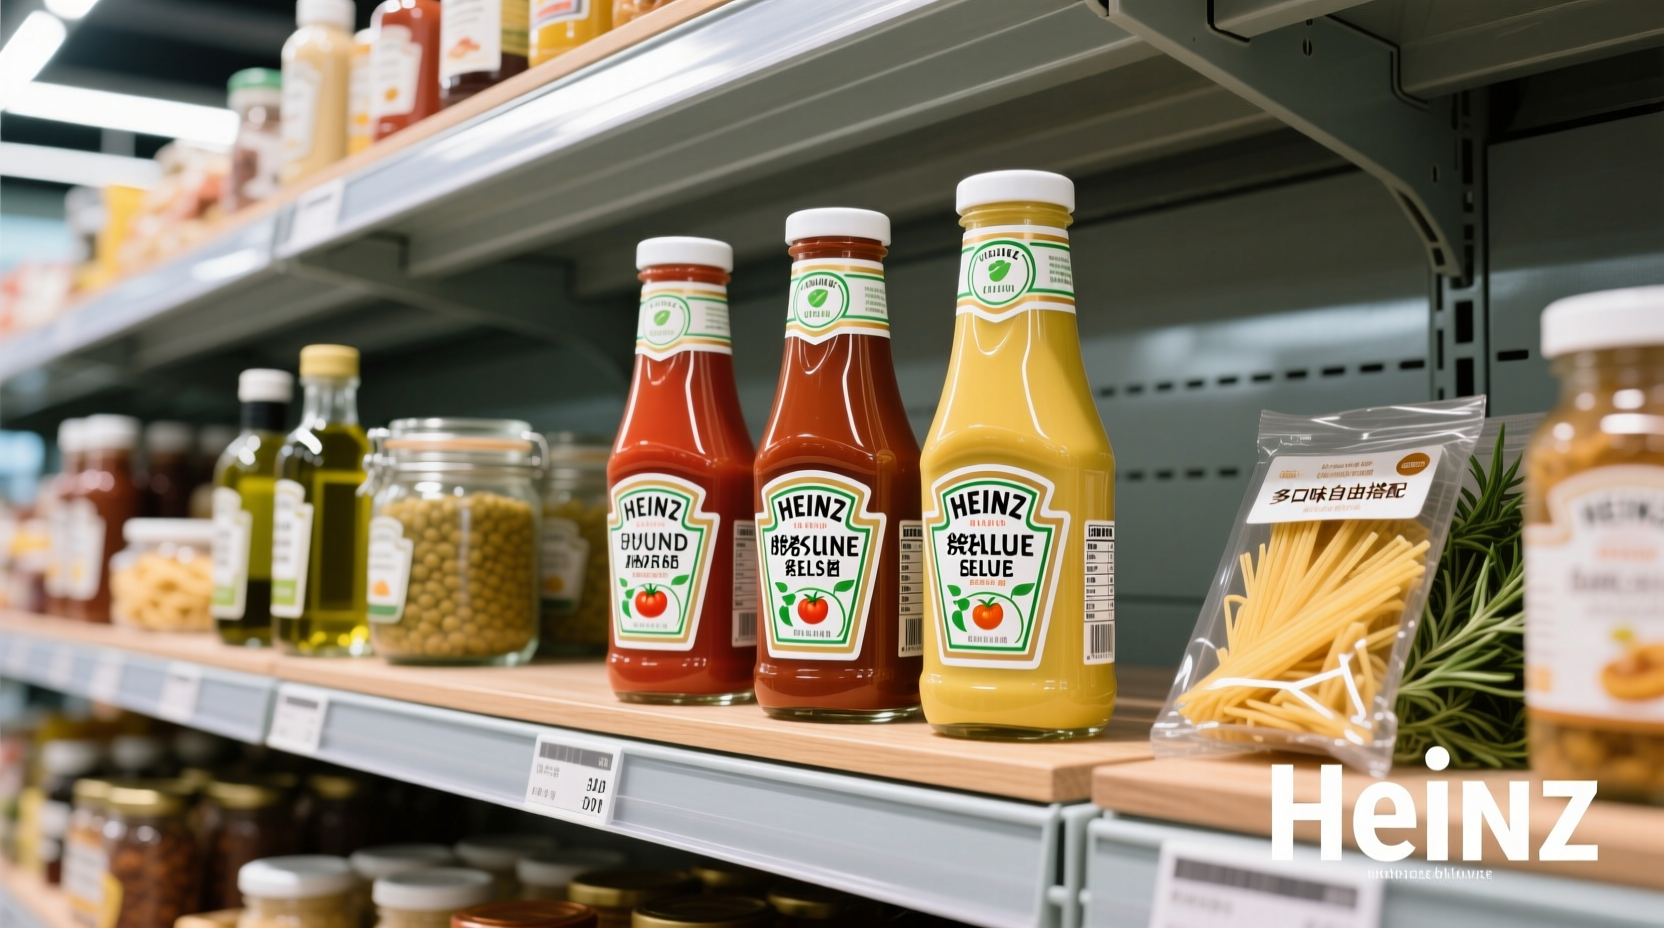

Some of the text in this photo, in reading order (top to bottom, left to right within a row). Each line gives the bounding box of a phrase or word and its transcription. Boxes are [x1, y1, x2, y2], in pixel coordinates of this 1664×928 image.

[950, 489, 1027, 521] HEINZ
[1269, 481, 1408, 505] 多口味自由搭配
[623, 496, 682, 522] HEINZ
[777, 494, 847, 523] HEINZ
